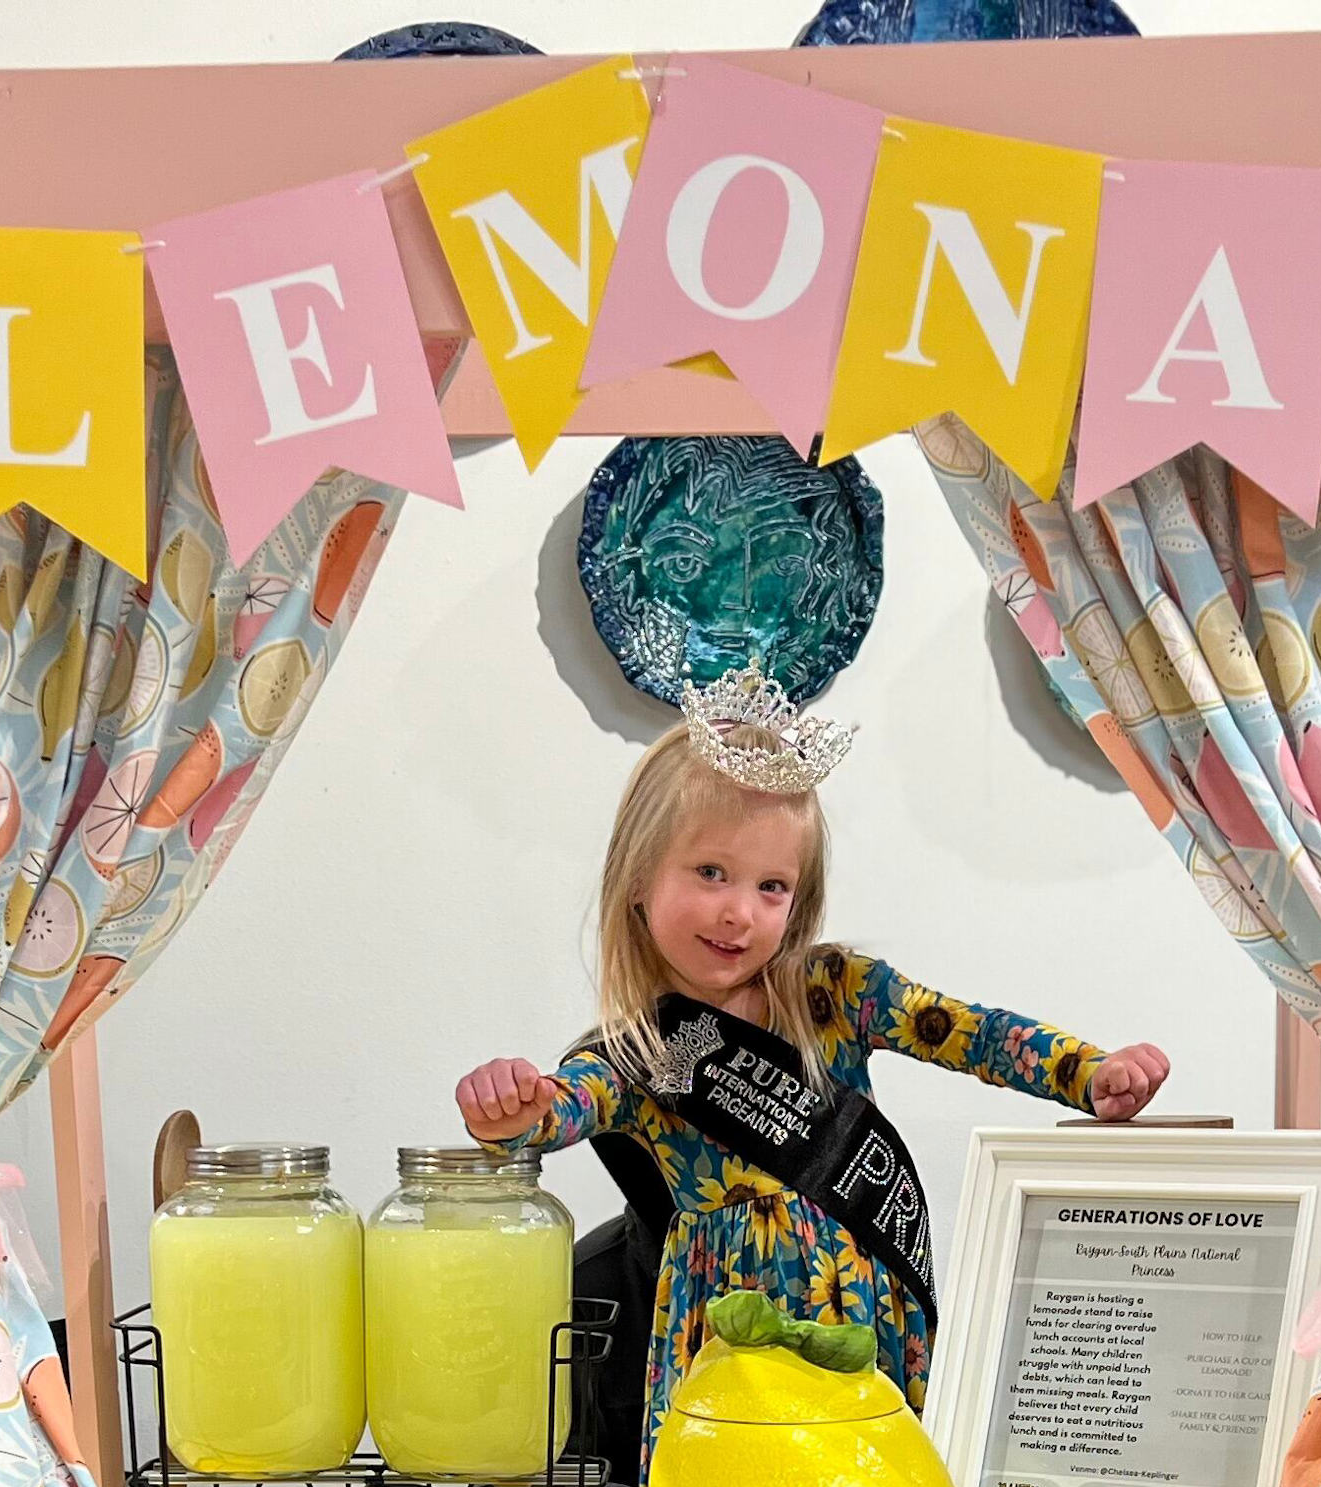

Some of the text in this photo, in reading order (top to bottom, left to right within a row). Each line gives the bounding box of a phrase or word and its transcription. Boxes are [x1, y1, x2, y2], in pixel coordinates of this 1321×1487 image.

[726, 1046, 821, 1118] PURE
[703, 1063, 812, 1140] INTERNATIONAL
[706, 1085, 789, 1146] PAGEANTS
[1058, 1209, 1263, 1227] GENERATIONS OF LOVE
[1154, 1245, 1186, 1259] Plains
[1192, 1248, 1241, 1261] National
[1132, 1264, 1175, 1277] Princess
[1047, 1292, 1084, 1303] Raygan
[1087, 1293, 1094, 1302] is
[1098, 1293, 1134, 1306] hosting
[1033, 1304, 1153, 1318] lemonade stand to raise
[1026, 1317, 1156, 1332] funds for clearing overdue
[1033, 1332, 1144, 1345] lunch accounts at local
[1203, 1332, 1224, 1341] HOW
[1030, 1346, 1142, 1359] schools. Many children
[1019, 1360, 1150, 1374] struggle with unpaid lunch
[1022, 1372, 1052, 1383] debts,
[1055, 1375, 1084, 1384] which
[1107, 1376, 1129, 1386] lead
[1132, 1378, 1141, 1387] to
[1010, 1385, 1151, 1403] them missing meals. Raygan
[1018, 1399, 1138, 1415] believes that every child
[1009, 1412, 1051, 1423] deserves
[1055, 1415, 1064, 1423] to
[1067, 1417, 1082, 1425] eat
[1095, 1419, 1143, 1429] nutritious
[1011, 1426, 1137, 1443] lunch and is committed to
[1021, 1440, 1057, 1453] making
[1069, 1444, 1122, 1456] difference.
